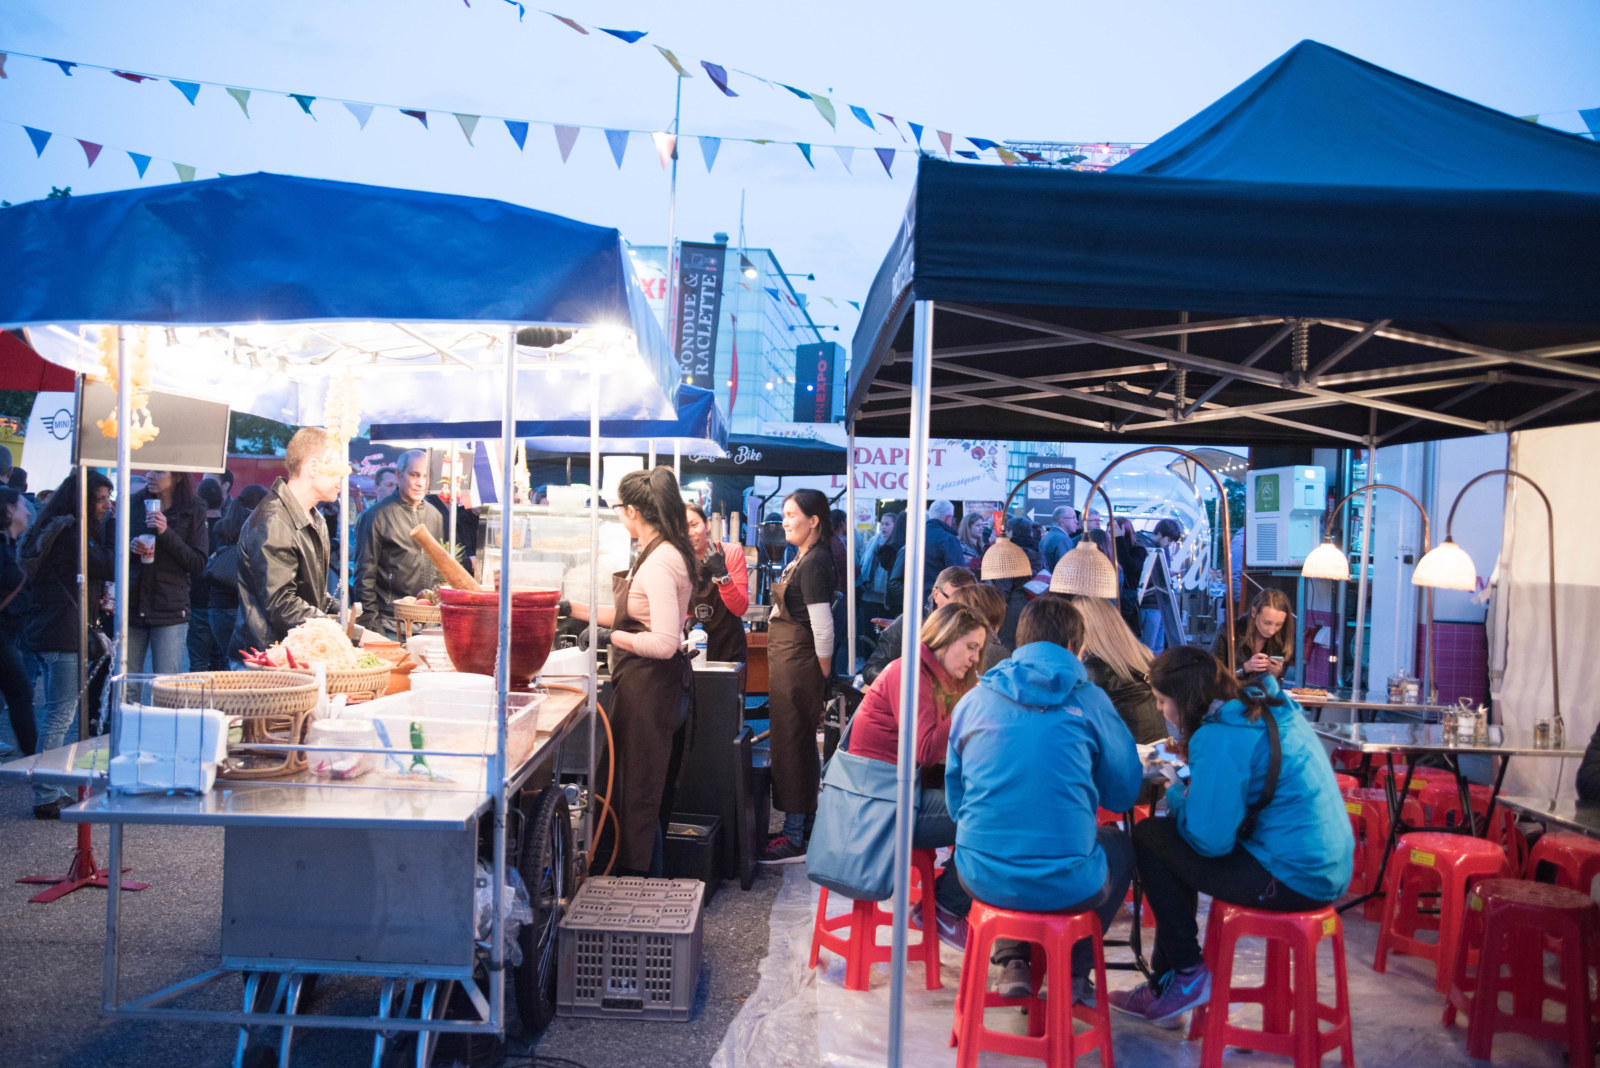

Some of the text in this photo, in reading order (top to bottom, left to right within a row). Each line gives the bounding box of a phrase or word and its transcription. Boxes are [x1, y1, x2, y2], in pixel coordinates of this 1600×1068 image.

[681, 273, 699, 375] FONDUE &
[695, 275, 717, 376] RACLETTE
[815, 360, 828, 423] RNEXPO
[54, 420, 70, 428] MINI
[734, 446, 763, 464] Bike
